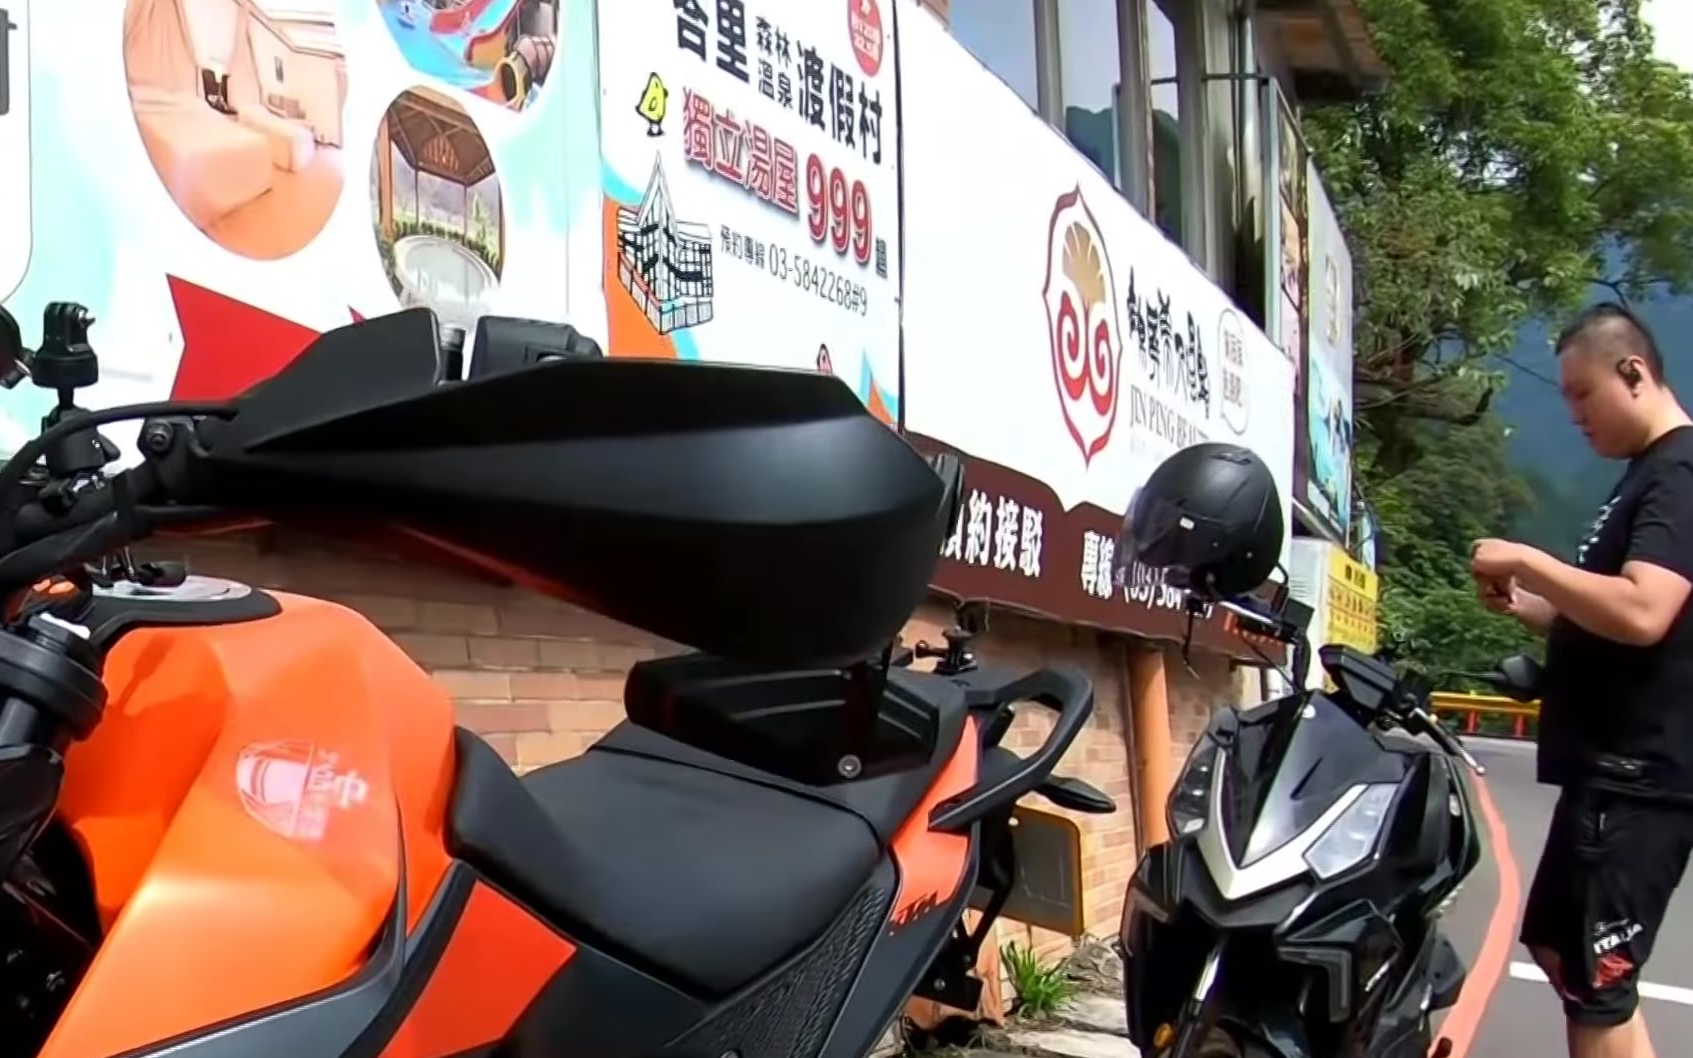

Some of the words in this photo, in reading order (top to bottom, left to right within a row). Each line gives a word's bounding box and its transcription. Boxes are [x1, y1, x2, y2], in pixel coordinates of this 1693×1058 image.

[683, 86, 800, 216] 獨立湯屋
[807, 152, 872, 266] 999
